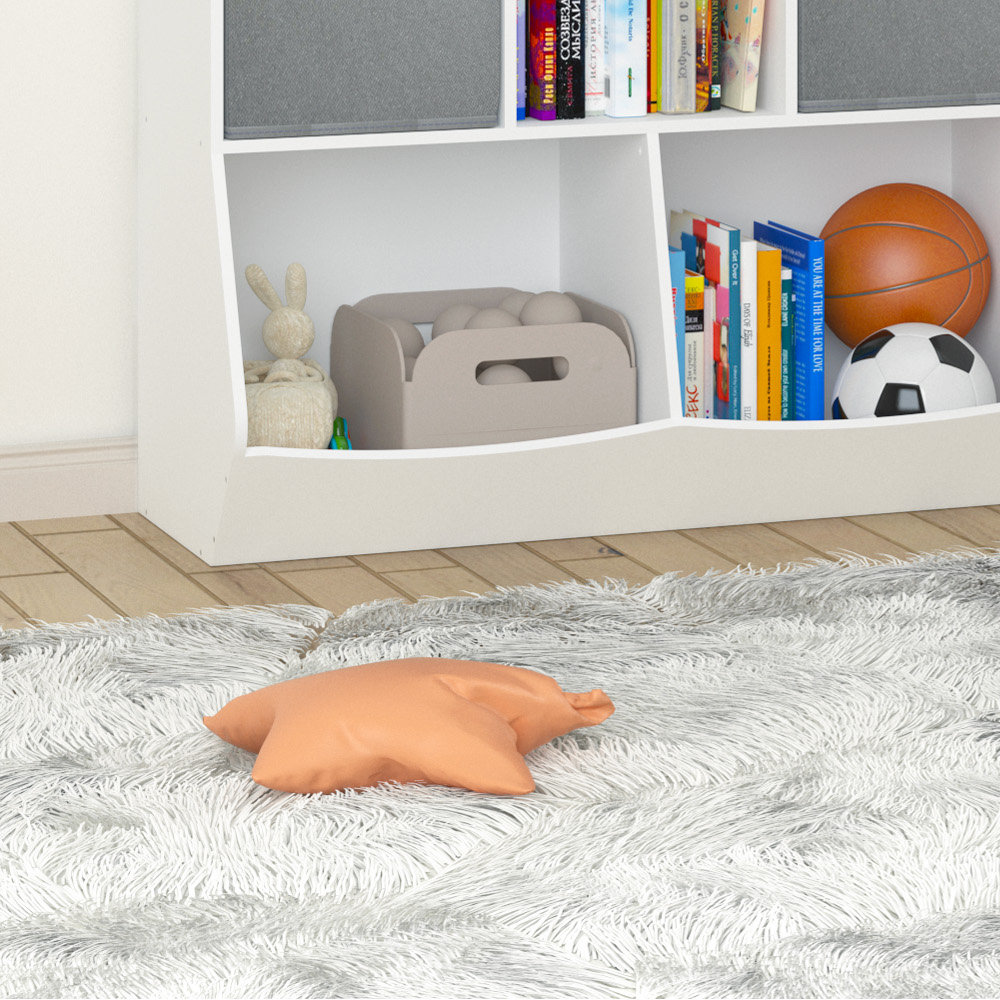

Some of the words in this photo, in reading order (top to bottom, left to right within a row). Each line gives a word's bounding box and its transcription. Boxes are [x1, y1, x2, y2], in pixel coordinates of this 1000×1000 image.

[571, 0, 581, 60] МЫСЛИ
[731, 249, 739, 262] Get
[731, 263, 739, 278] Over
[813, 257, 823, 274] YOU
[813, 274, 823, 288] ARE
[813, 289, 823, 299] AT
[743, 303, 751, 318] DAYS
[813, 300, 823, 315] THE
[743, 318, 751, 328] OF
[813, 317, 823, 335] TIME
[813, 337, 823, 353] FOR
[813, 354, 823, 372] LOVE
